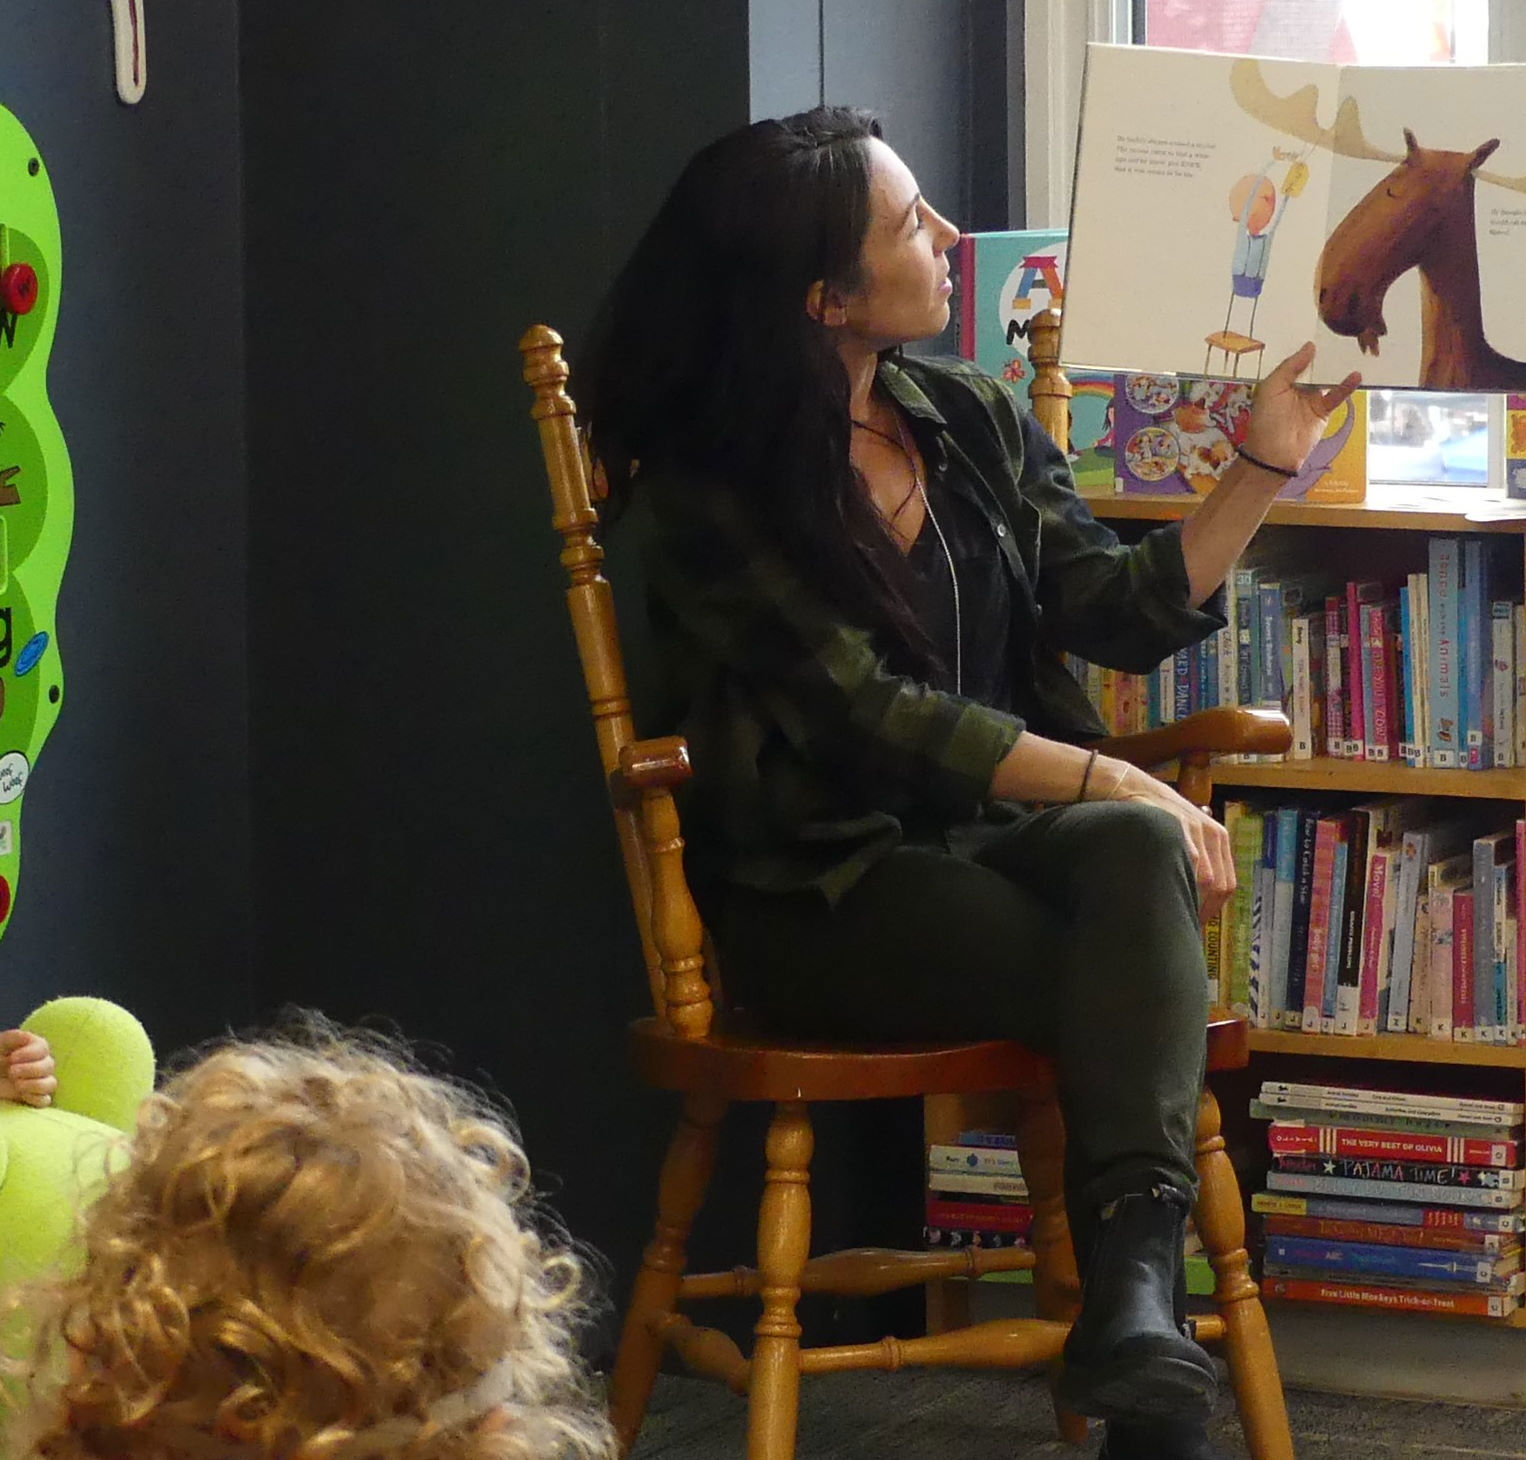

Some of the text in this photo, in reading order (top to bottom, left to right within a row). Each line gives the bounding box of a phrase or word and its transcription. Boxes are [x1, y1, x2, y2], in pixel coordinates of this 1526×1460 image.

[1006, 319, 1030, 345] M
[1439, 640, 1450, 698] Animals
[1372, 863, 1383, 899] Move!
[1341, 1138, 1357, 1146] THE
[1359, 1140, 1379, 1149] VERY
[1382, 1141, 1401, 1150] BEST
[1416, 1144, 1442, 1153] OLIVIA
[1343, 1160, 1404, 1182] PAJAMA
[1410, 1166, 1456, 1184] TIME!
[1321, 1288, 1339, 1298] Five
[1339, 1290, 1360, 1300] Little
[1361, 1291, 1398, 1303] Monkeys
